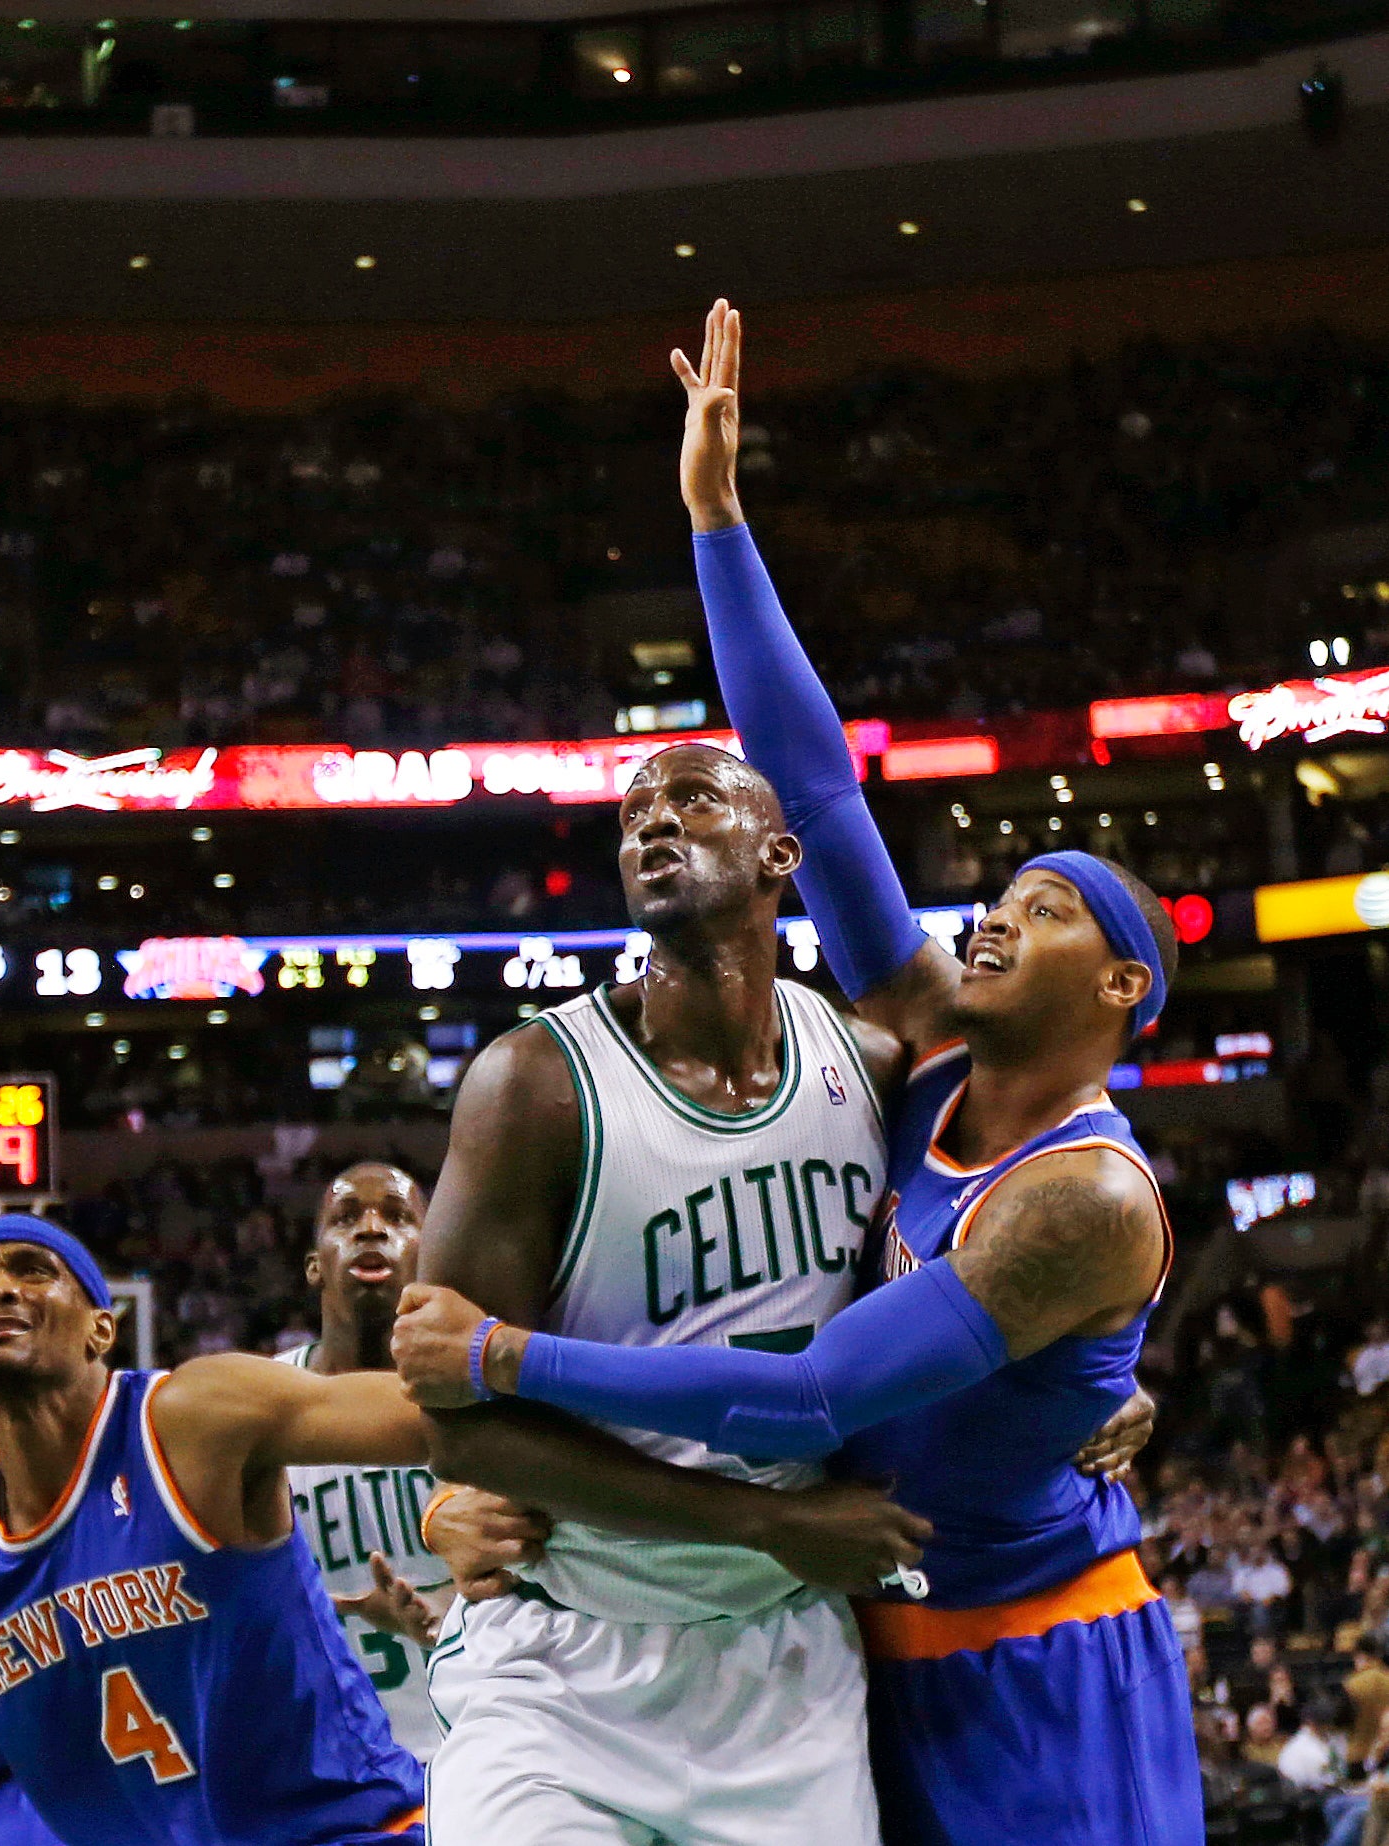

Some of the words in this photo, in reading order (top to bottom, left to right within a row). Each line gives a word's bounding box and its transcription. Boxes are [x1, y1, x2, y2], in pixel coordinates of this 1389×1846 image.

[643, 1157, 872, 1327] CELTICS
[54, 1560, 210, 1649] YORK
[100, 1665, 198, 1786] 4
